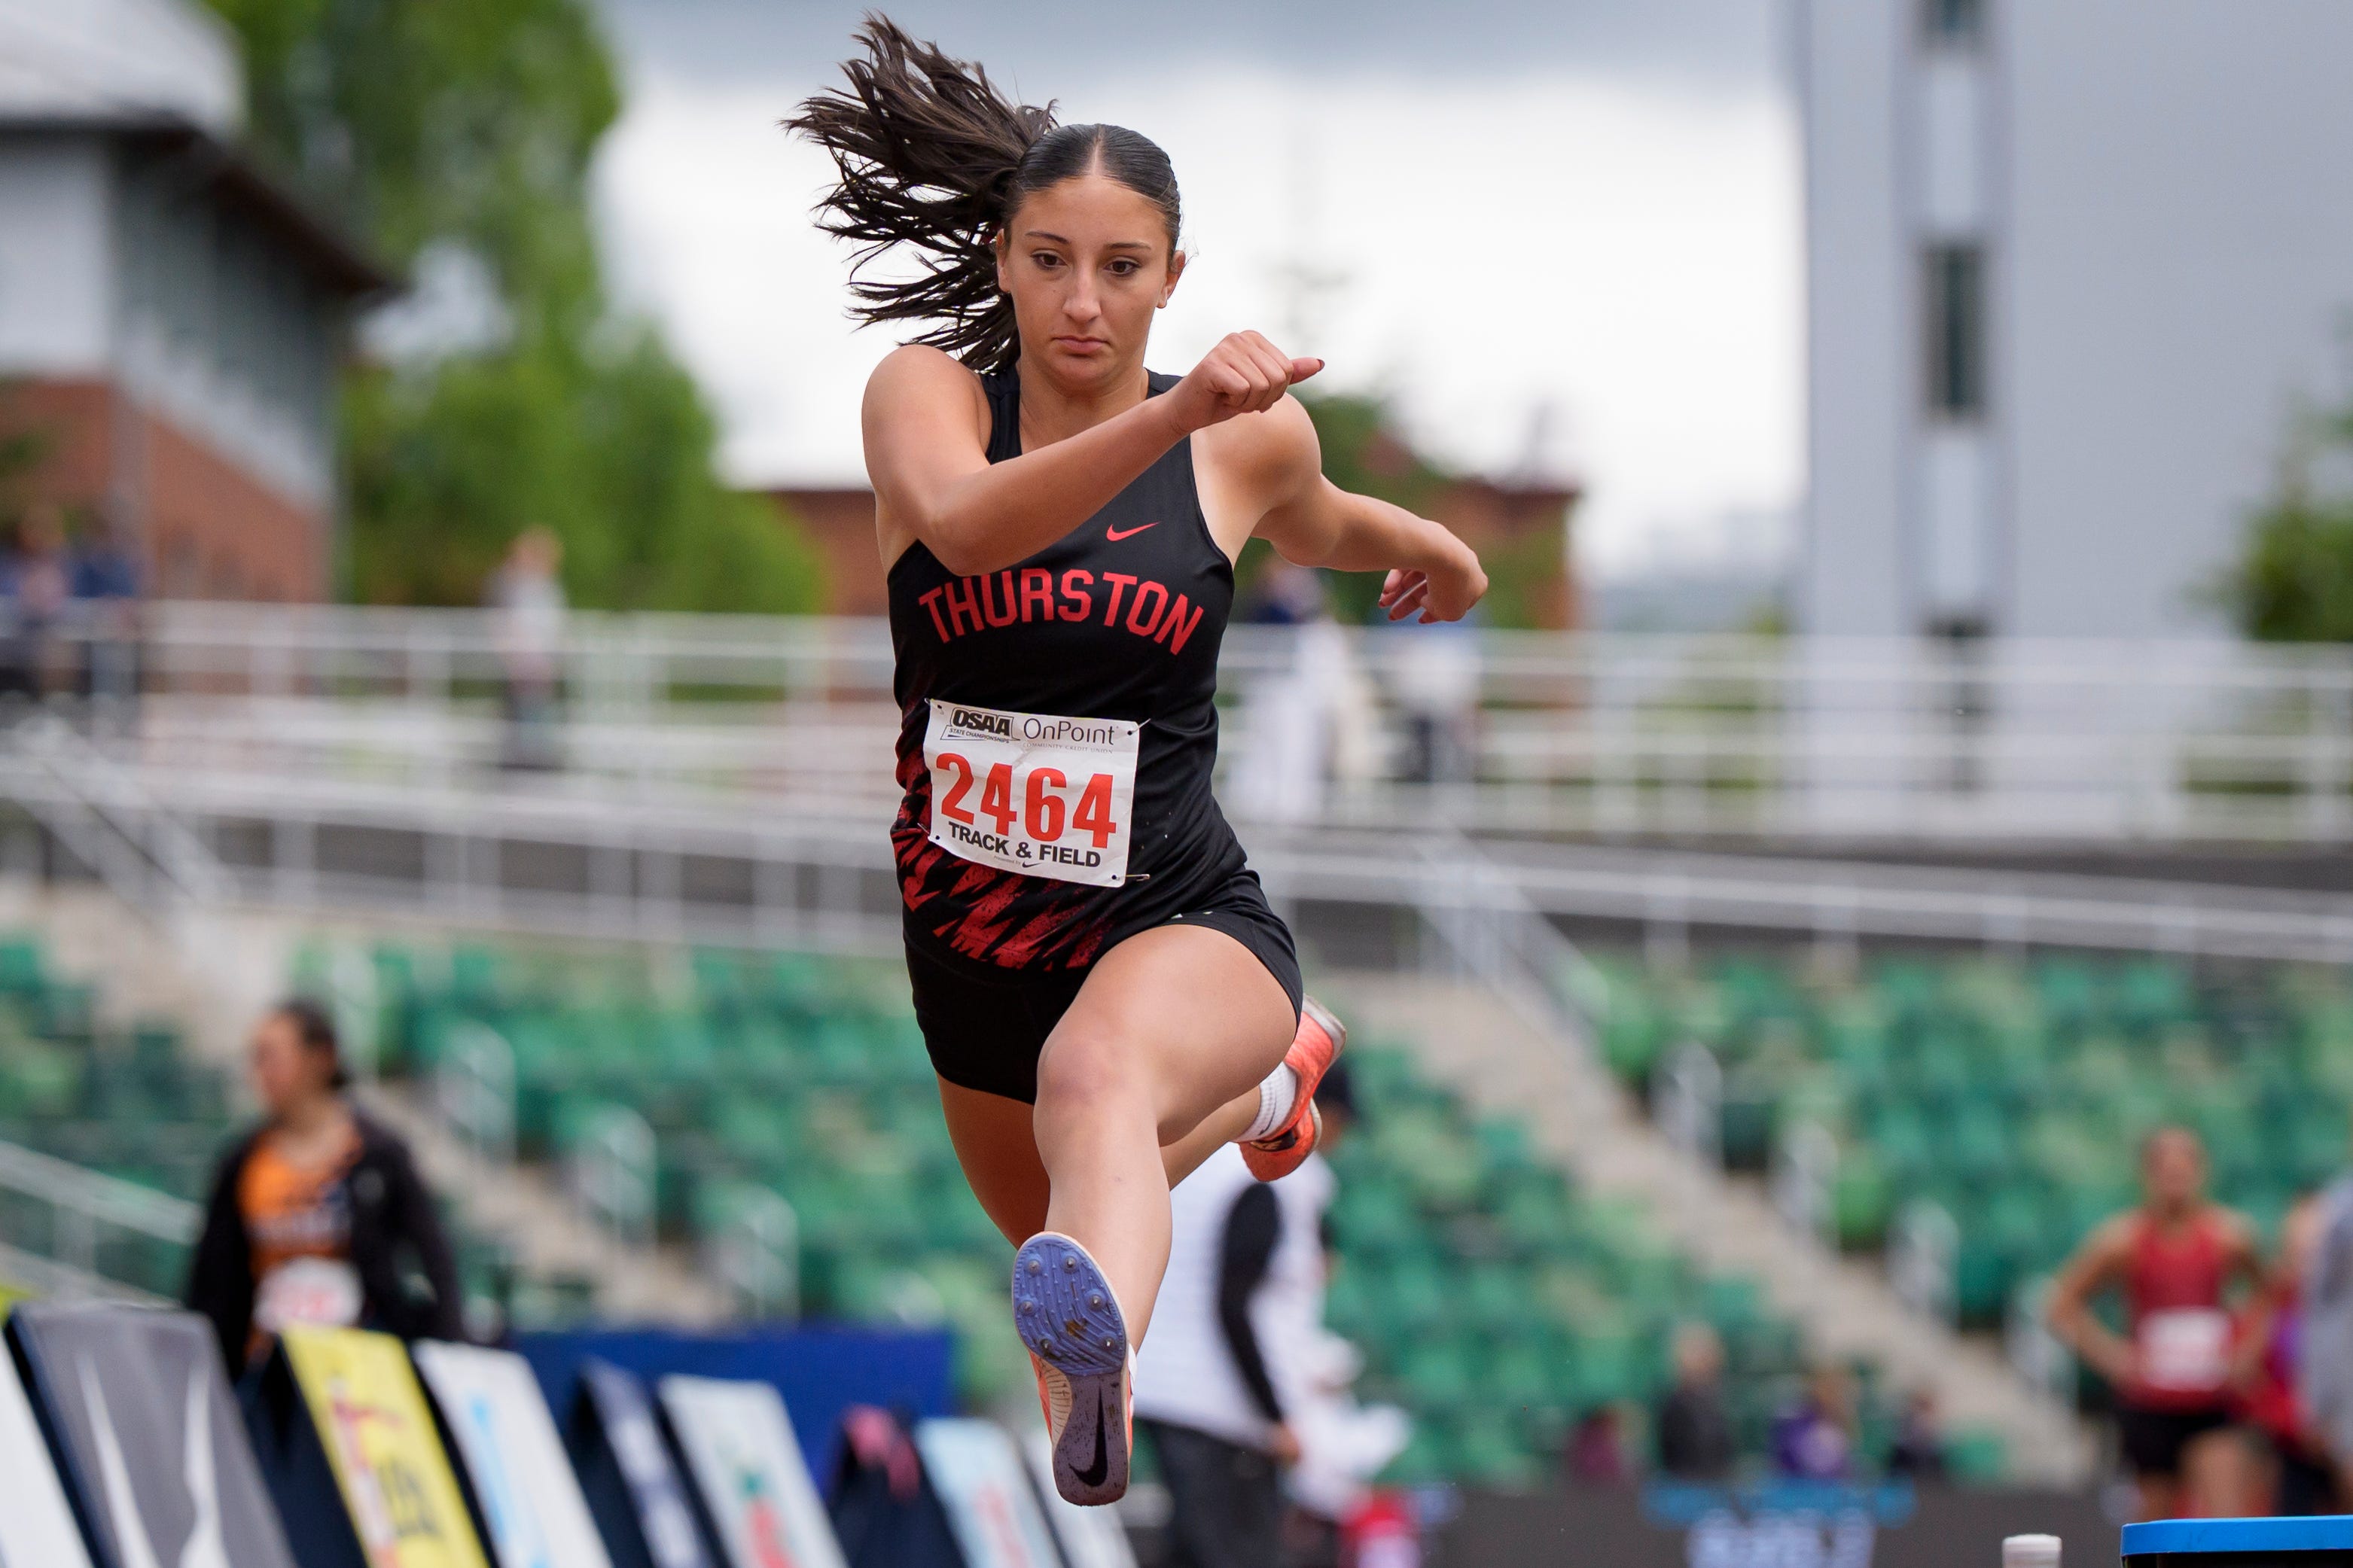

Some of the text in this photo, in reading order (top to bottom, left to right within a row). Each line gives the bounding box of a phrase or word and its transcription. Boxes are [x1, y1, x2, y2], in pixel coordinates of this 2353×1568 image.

[918, 568, 1203, 656] THURSTON
[949, 727, 1010, 744] STATE CHAMPIONSHIPS
[952, 710, 1010, 736] OSAA
[1023, 718, 1114, 745] OnPoint
[936, 753, 1117, 849] 2464
[949, 821, 1101, 867] TRACK & FIELD
